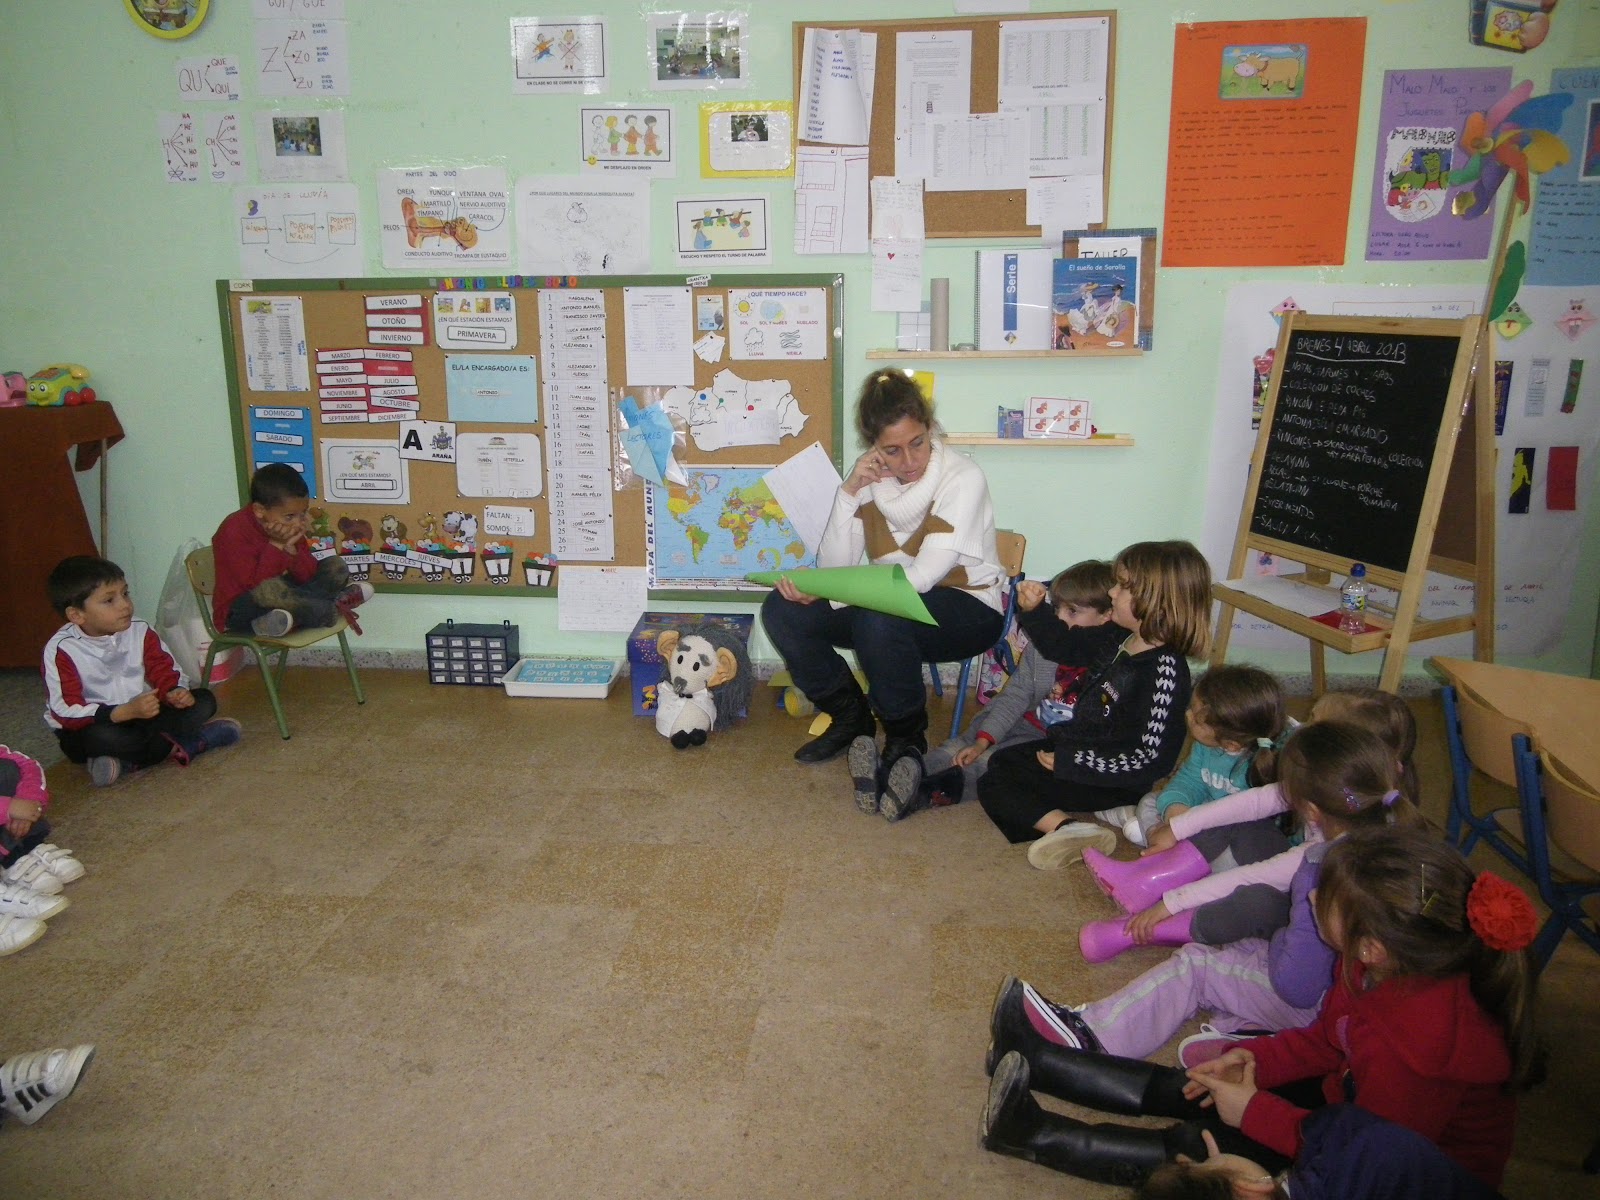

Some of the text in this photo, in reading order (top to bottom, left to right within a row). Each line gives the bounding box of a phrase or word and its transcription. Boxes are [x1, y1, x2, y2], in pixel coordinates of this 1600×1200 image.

[290, 30, 306, 41] ZA
[210, 57, 227, 67] QUE
[261, 46, 283, 73] Z
[294, 50, 310, 64] ZO
[178, 68, 203, 93] QU
[296, 76, 313, 89] ZU
[161, 138, 171, 148] H
[205, 137, 216, 146] CH
[1006, 264, 1017, 294] Serie
[382, 316, 406, 325] OTOÑO
[380, 334, 412, 342] INVIERNO
[457, 330, 496, 339] PRIMAVERA
[1296, 338, 1332, 353] BRENES
[1334, 336, 1344, 357] 4
[1376, 342, 1407, 362] 2013
[380, 398, 411, 408] OCTUBRE
[402, 429, 423, 451] A
[486, 512, 513, 520] FALTAN:
[380, 554, 417, 565] MIÉRCOLES
[418, 554, 440, 564] JUEVES
